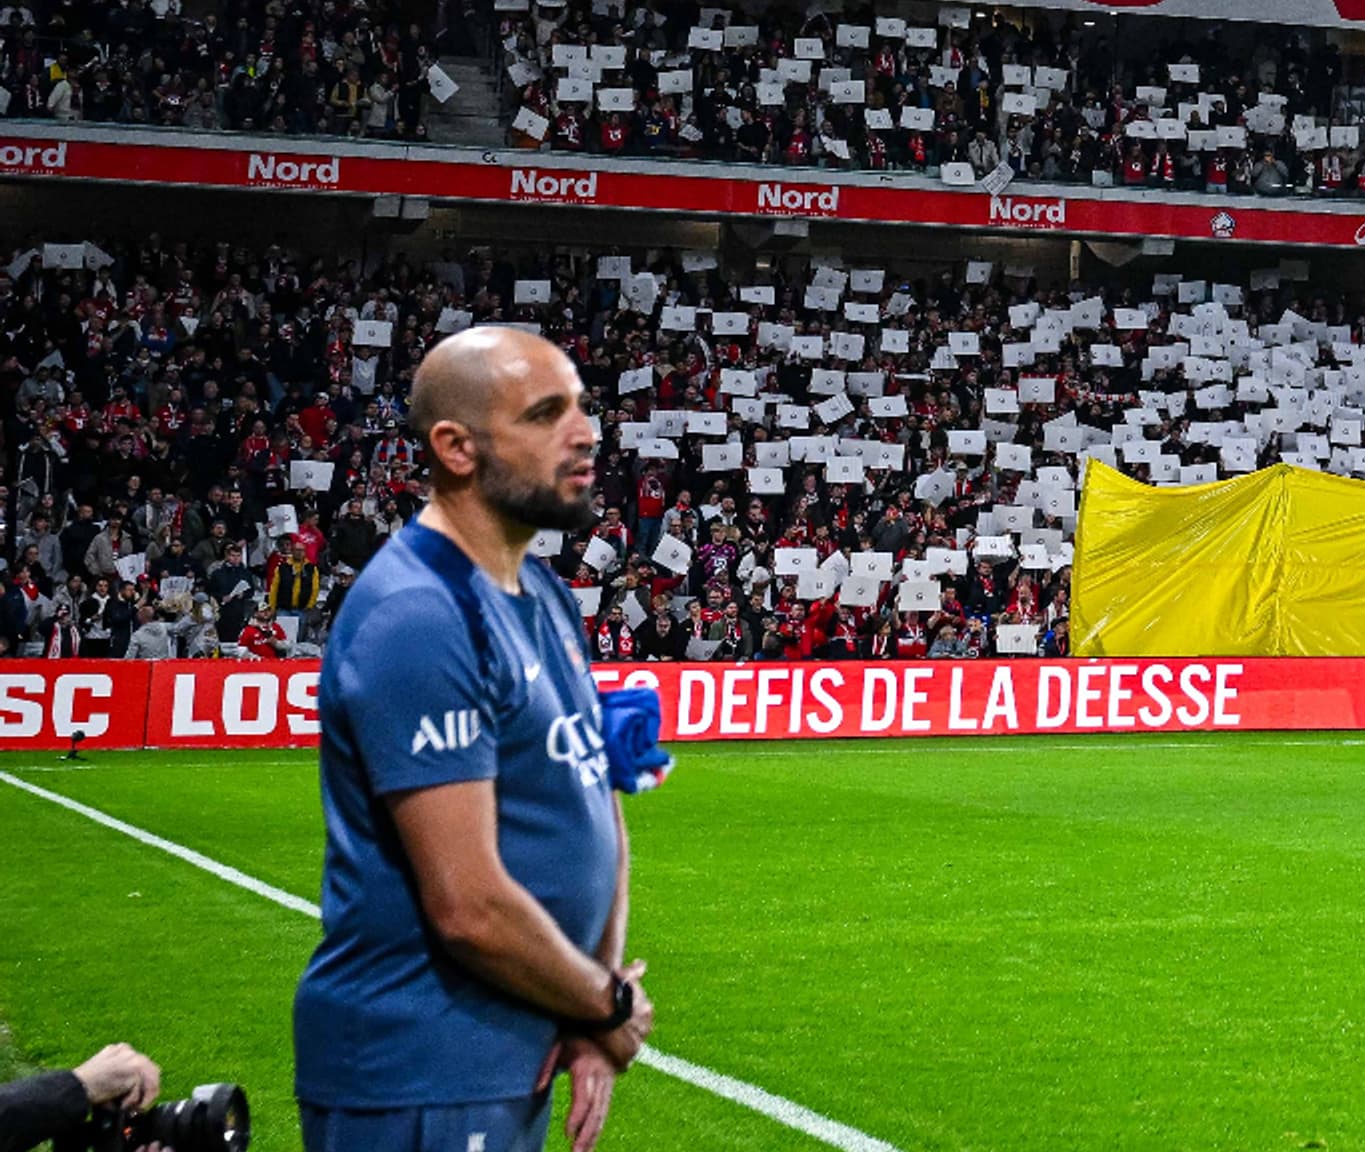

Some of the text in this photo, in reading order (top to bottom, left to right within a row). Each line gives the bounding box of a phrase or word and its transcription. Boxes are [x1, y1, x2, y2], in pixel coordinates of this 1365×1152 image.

[0, 142, 68, 168] ord
[247, 154, 341, 184] Nord
[510, 168, 598, 198] Nord
[757, 183, 840, 211] Nord
[989, 197, 1066, 224] Nord
[170, 671, 321, 736] LOS
[676, 654, 1243, 736] DÉFIS DE LA DÉESSE
